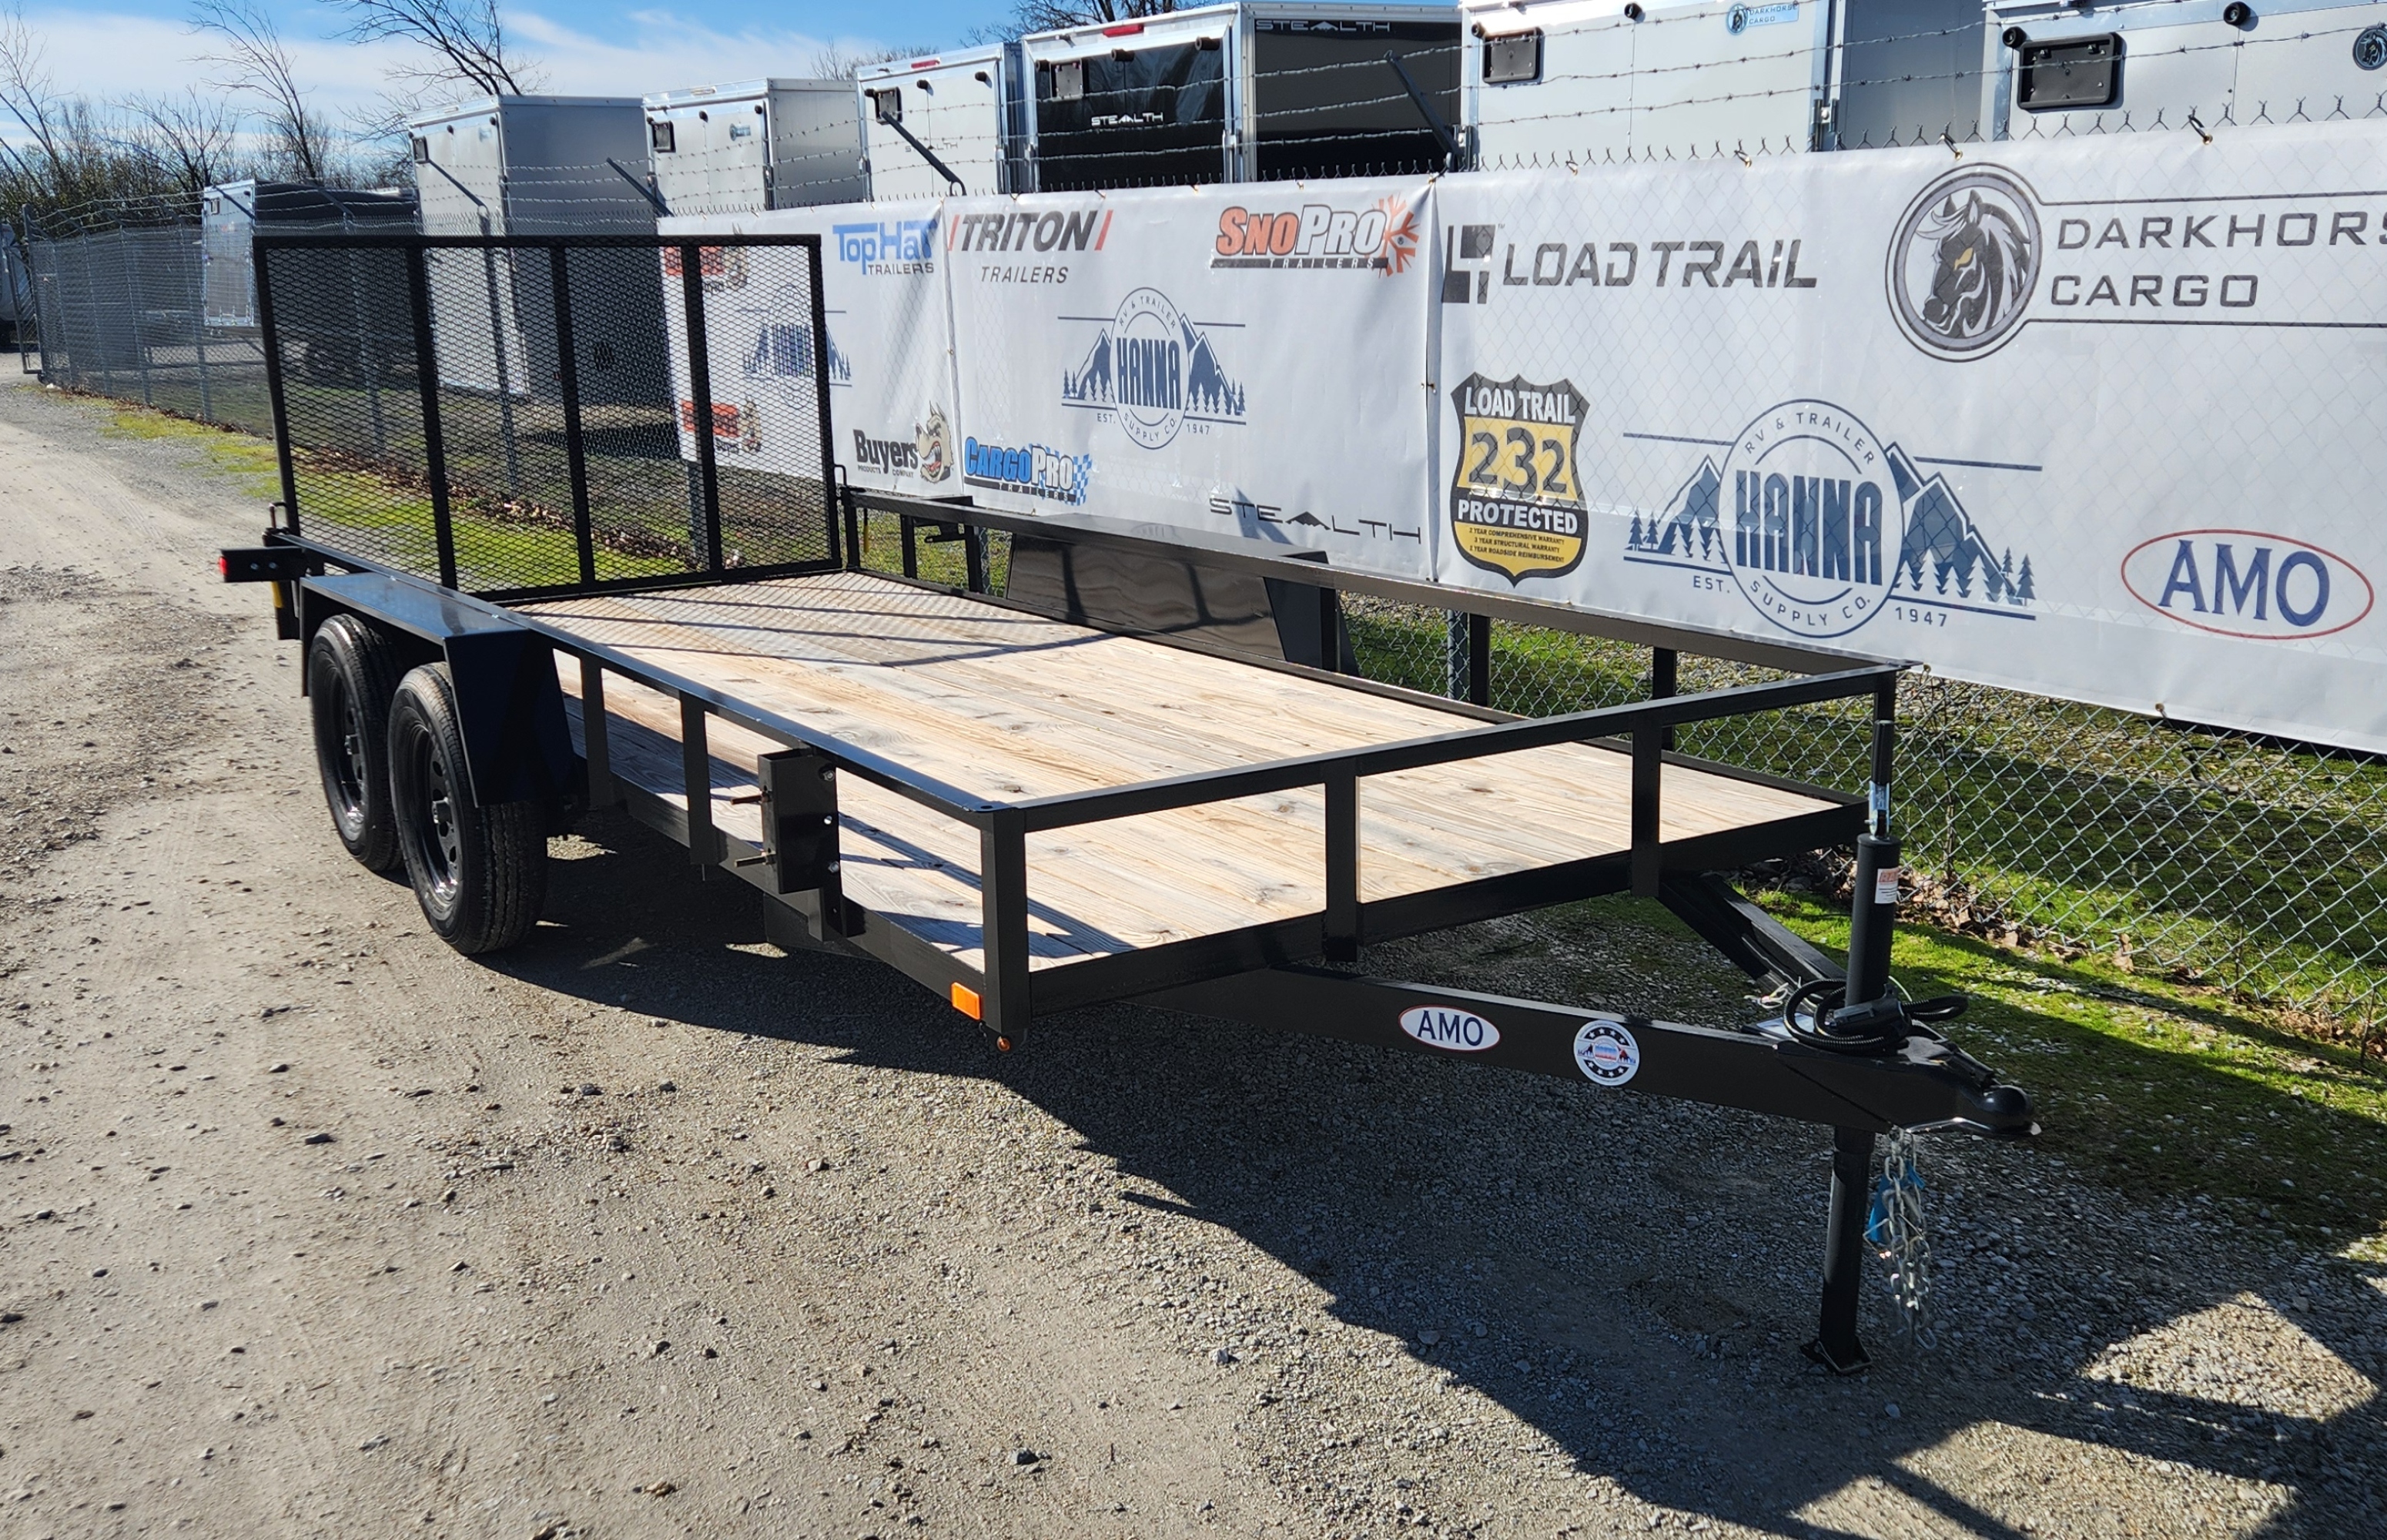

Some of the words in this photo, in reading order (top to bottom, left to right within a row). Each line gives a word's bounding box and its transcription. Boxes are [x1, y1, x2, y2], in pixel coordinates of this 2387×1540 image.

[1255, 19, 1390, 32] STEALTH
[1749, 16, 1776, 25] CARGO
[1091, 111, 1163, 126] STEALTH
[960, 210, 1097, 252] TRITON
[2057, 211, 2387, 249] DARKHOR
[868, 263, 935, 275] TRAILERS
[980, 266, 1069, 283] TRAILERS
[1270, 258, 1375, 269] TRAILERS
[1503, 241, 1639, 287] LOAD
[1652, 239, 1817, 288] TRAIL
[2051, 274, 2258, 307] CARGO
[1140, 296, 1177, 329] TRAILER
[1116, 336, 1181, 410] HANNA
[1097, 413, 1115, 424] EST.
[1465, 386, 1515, 417] LOAD
[1518, 390, 1576, 424] TRAIL
[1123, 413, 1159, 441] SUPPLY
[1187, 424, 1210, 435] 1947
[1745, 429, 1766, 456] RV
[1776, 417, 1786, 430] &
[1796, 412, 1875, 464] TRAILER
[853, 429, 919, 474] Buyers
[1468, 427, 1567, 500] 232
[858, 464, 881, 474] PRODUCTS
[999, 482, 1069, 500] TRAILERS
[1209, 497, 1422, 544] STEALTH
[1458, 499, 1578, 534] PROTECTED
[1736, 469, 1883, 586] HANNA
[1488, 530, 1537, 541] COMPREHENSIVE
[1538, 535, 1565, 544] WARRANTY
[1494, 539, 1529, 549] STRUCTURAL
[1532, 544, 1559, 553] WARRANTY
[1488, 547, 1516, 556] ROADSIDE
[1518, 551, 1565, 562] REIMBURSEMENT
[1692, 574, 1730, 594] EST.
[2158, 539, 2330, 627] AMO
[1749, 580, 1829, 627] SUPPLY
[1842, 597, 1871, 619] CO.
[1894, 607, 1947, 628] 1947
[1417, 1009, 1484, 1046] AMO
